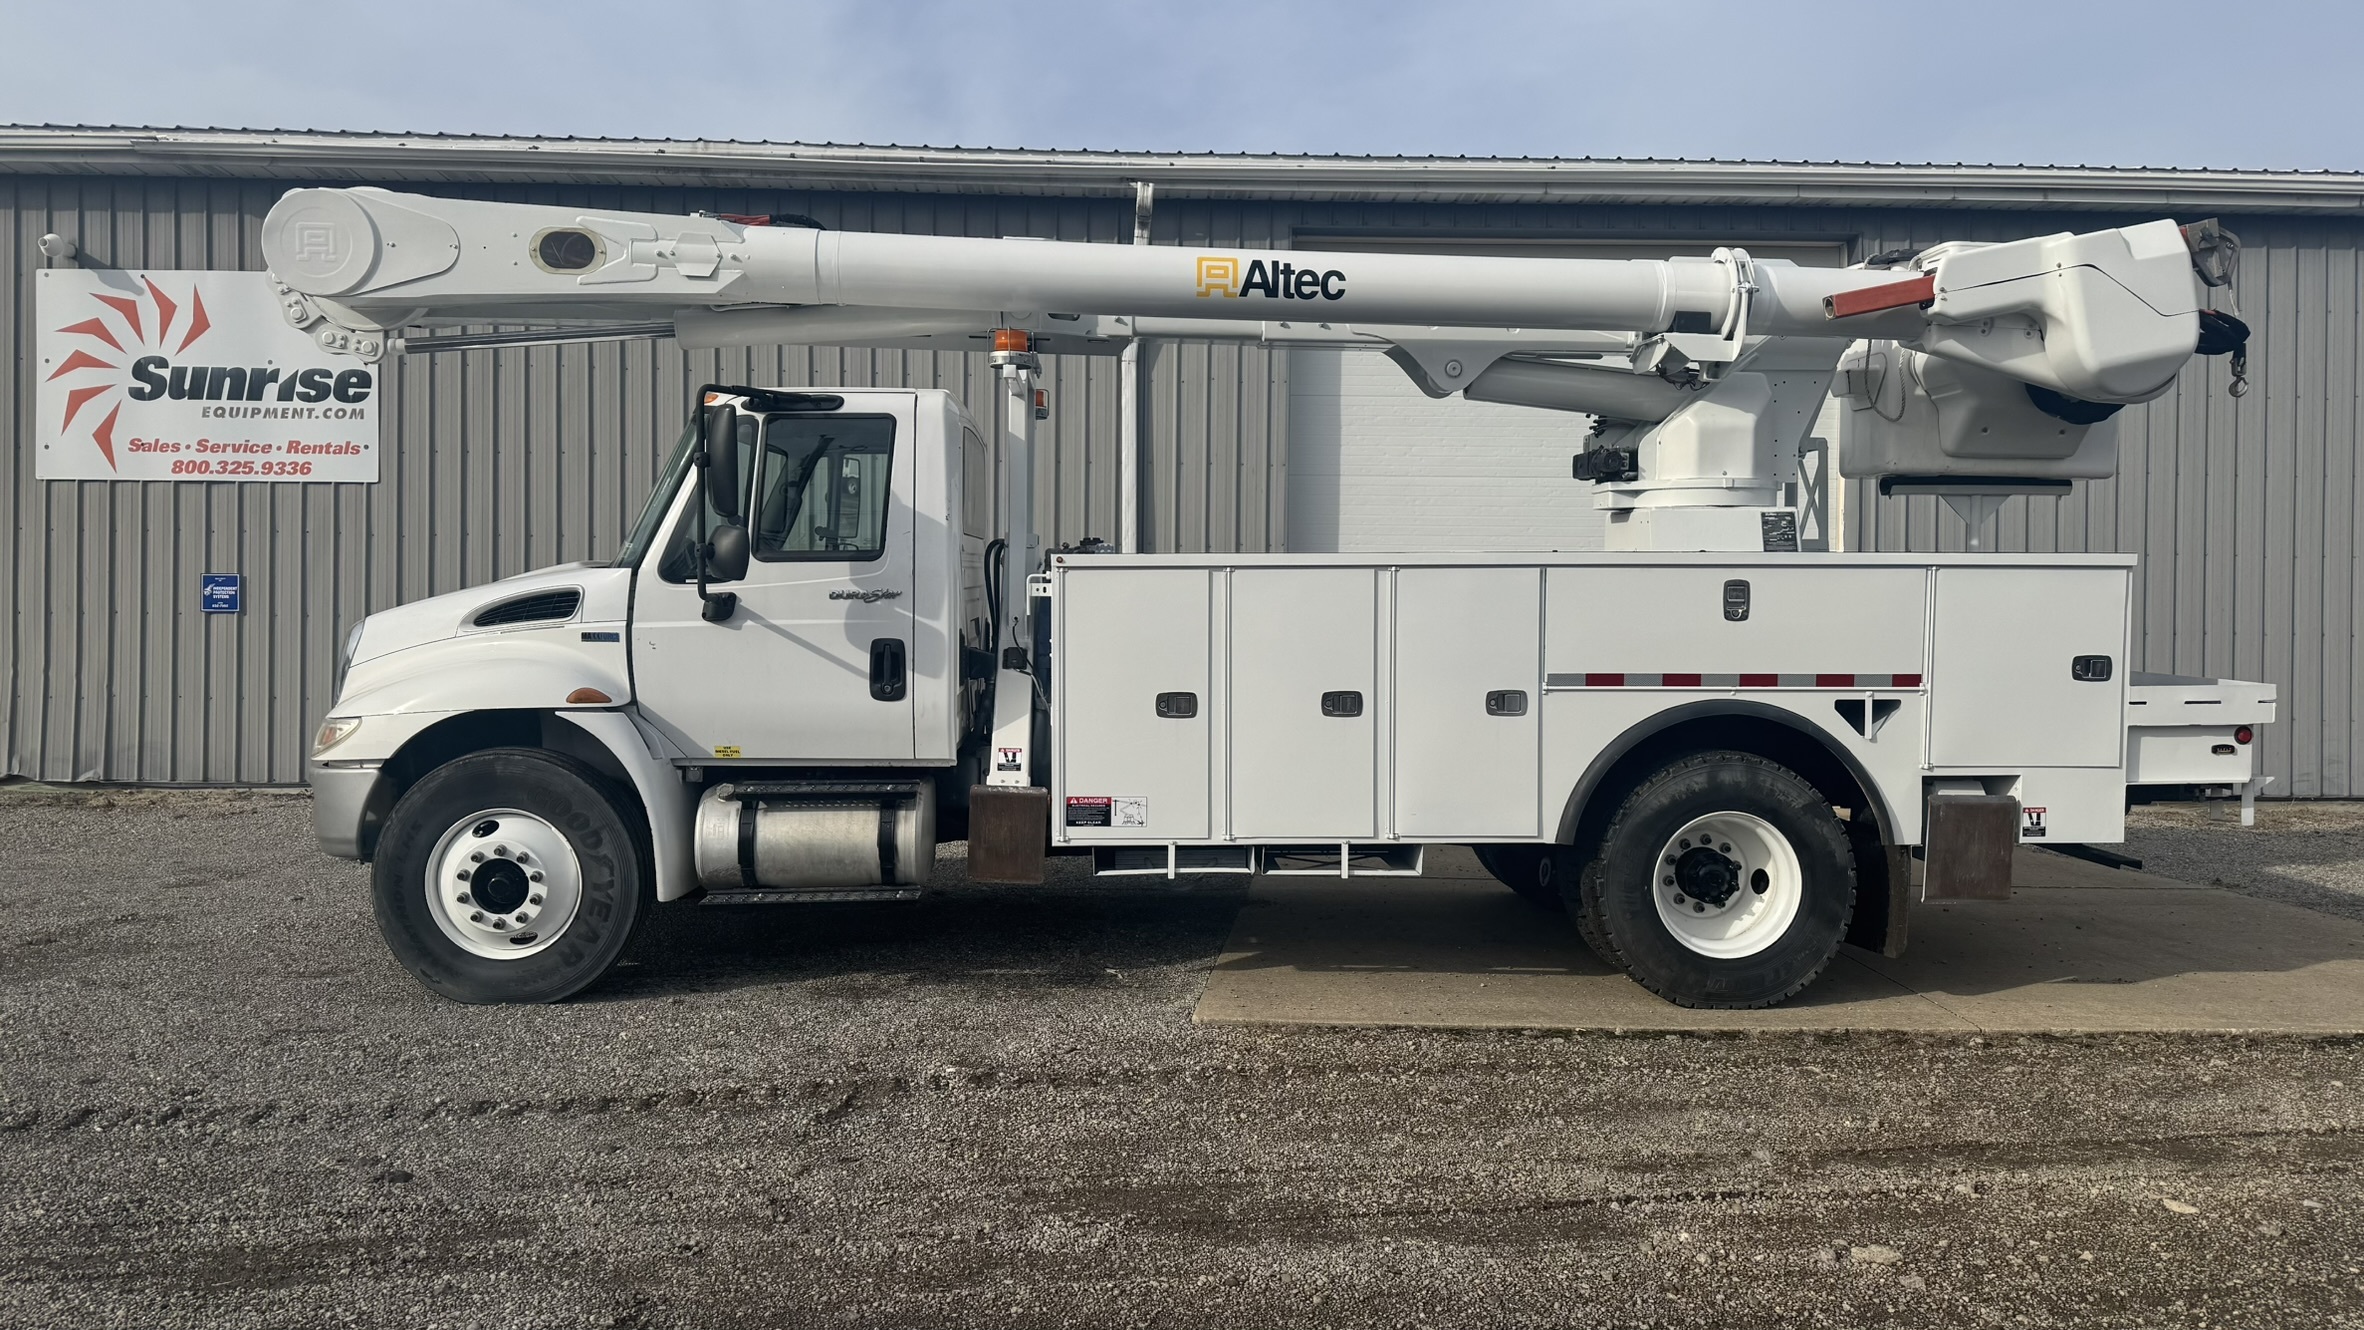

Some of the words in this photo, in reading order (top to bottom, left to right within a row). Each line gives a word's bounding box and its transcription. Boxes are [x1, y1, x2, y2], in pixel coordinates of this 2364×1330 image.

[1239, 259, 1346, 300] Altec
[128, 355, 372, 403] Sunrise
[201, 406, 365, 419] EQUIPMENT.COM
[128, 438, 181, 453] Sales
[195, 439, 272, 454] Service
[286, 440, 361, 455] Rentals
[171, 460, 312, 475] 800.325.9336
